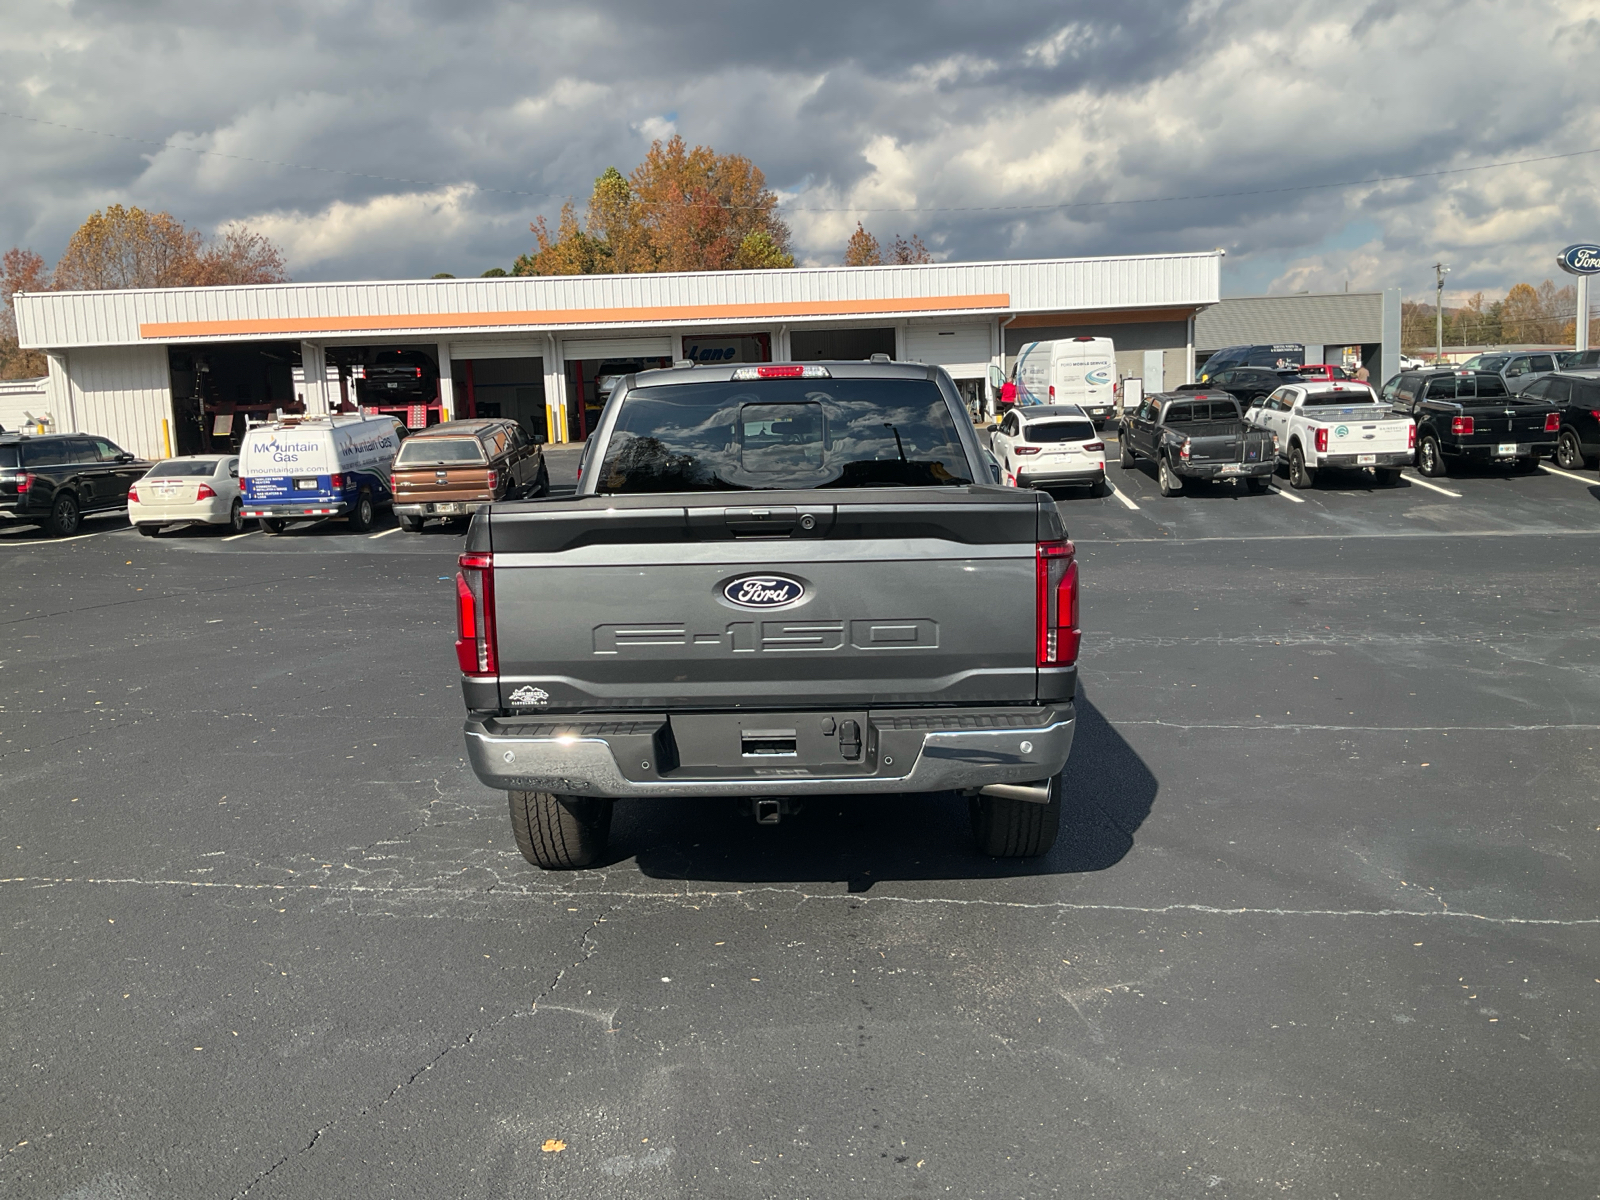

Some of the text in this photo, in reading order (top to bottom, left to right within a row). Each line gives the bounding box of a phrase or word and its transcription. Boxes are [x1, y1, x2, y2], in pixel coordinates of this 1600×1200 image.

[688, 345, 736, 361] Lane
[253, 439, 319, 453] Mountain
[273, 452, 299, 463] Gas
[250, 466, 325, 474] mountaingas.com
[738, 580, 790, 602] Ford
[592, 617, 940, 655] F-150
